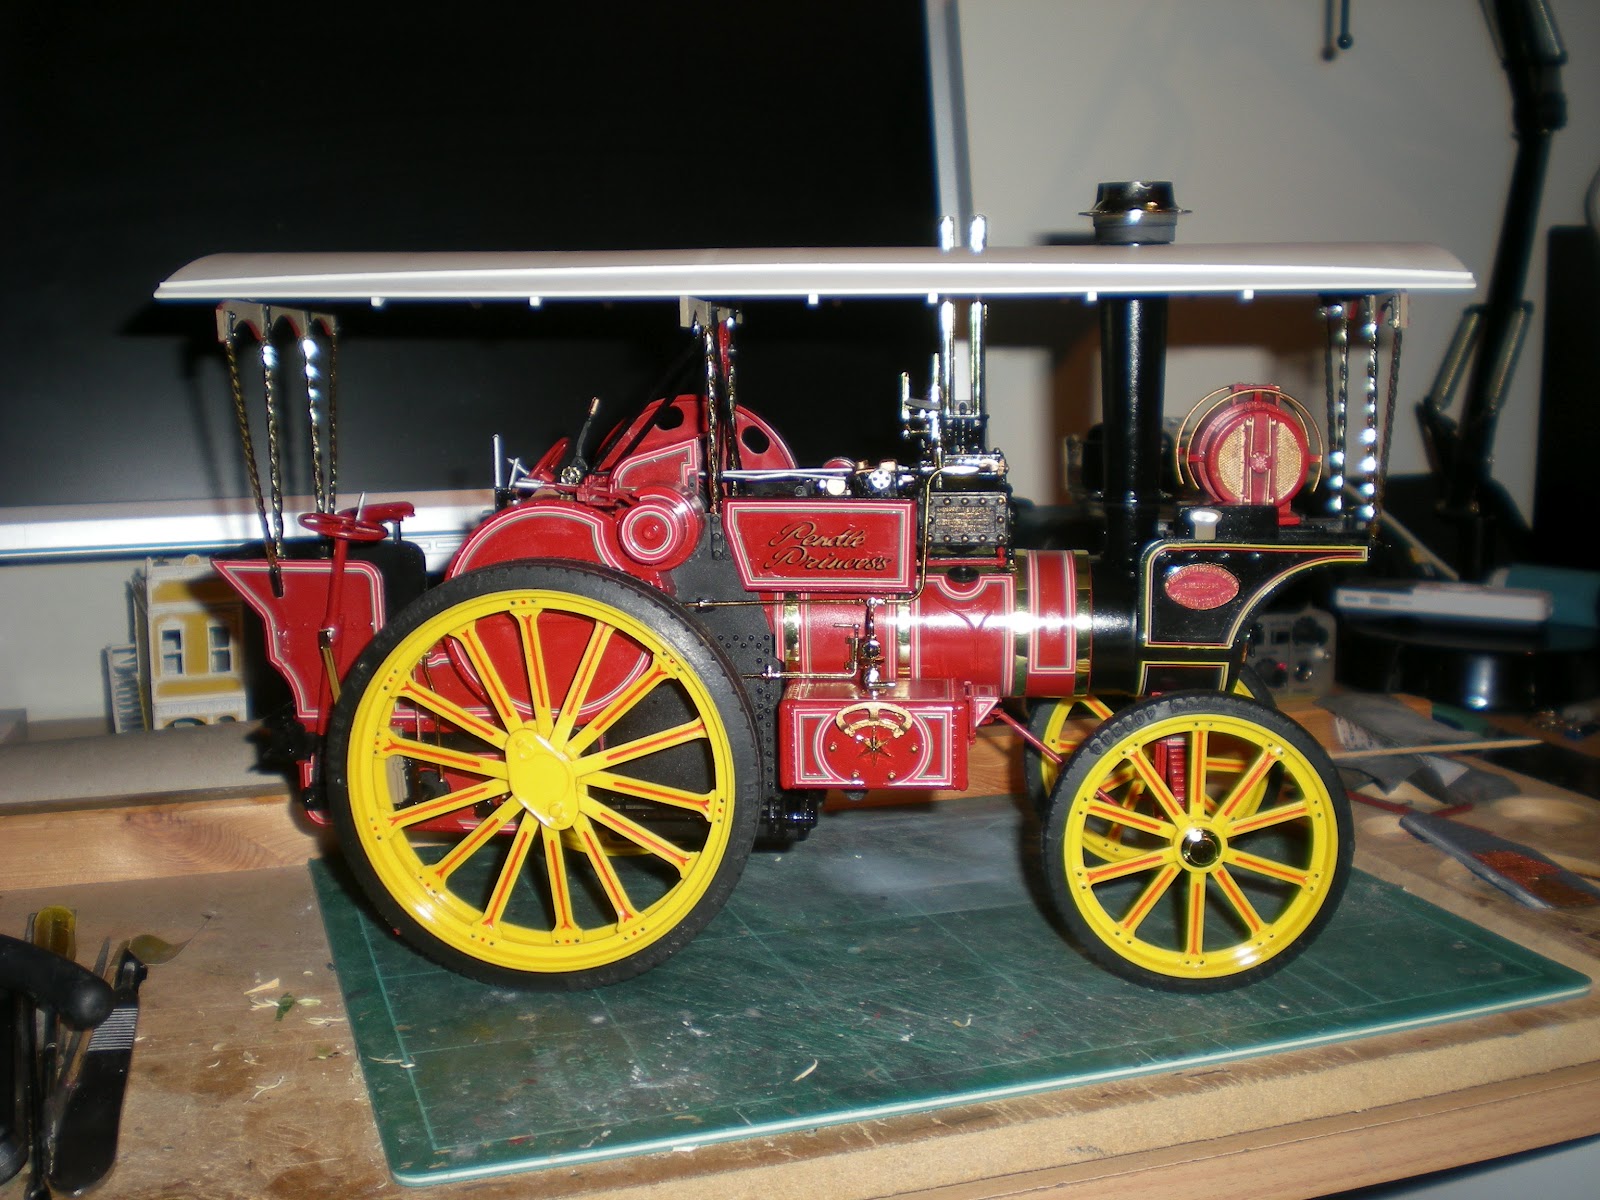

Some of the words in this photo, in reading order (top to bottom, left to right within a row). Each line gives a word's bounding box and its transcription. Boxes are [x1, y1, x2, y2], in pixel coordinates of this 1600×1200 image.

[768, 521, 866, 549] Pendle
[763, 545, 892, 571] Princess
[1089, 708, 1156, 755] DUNLOP
